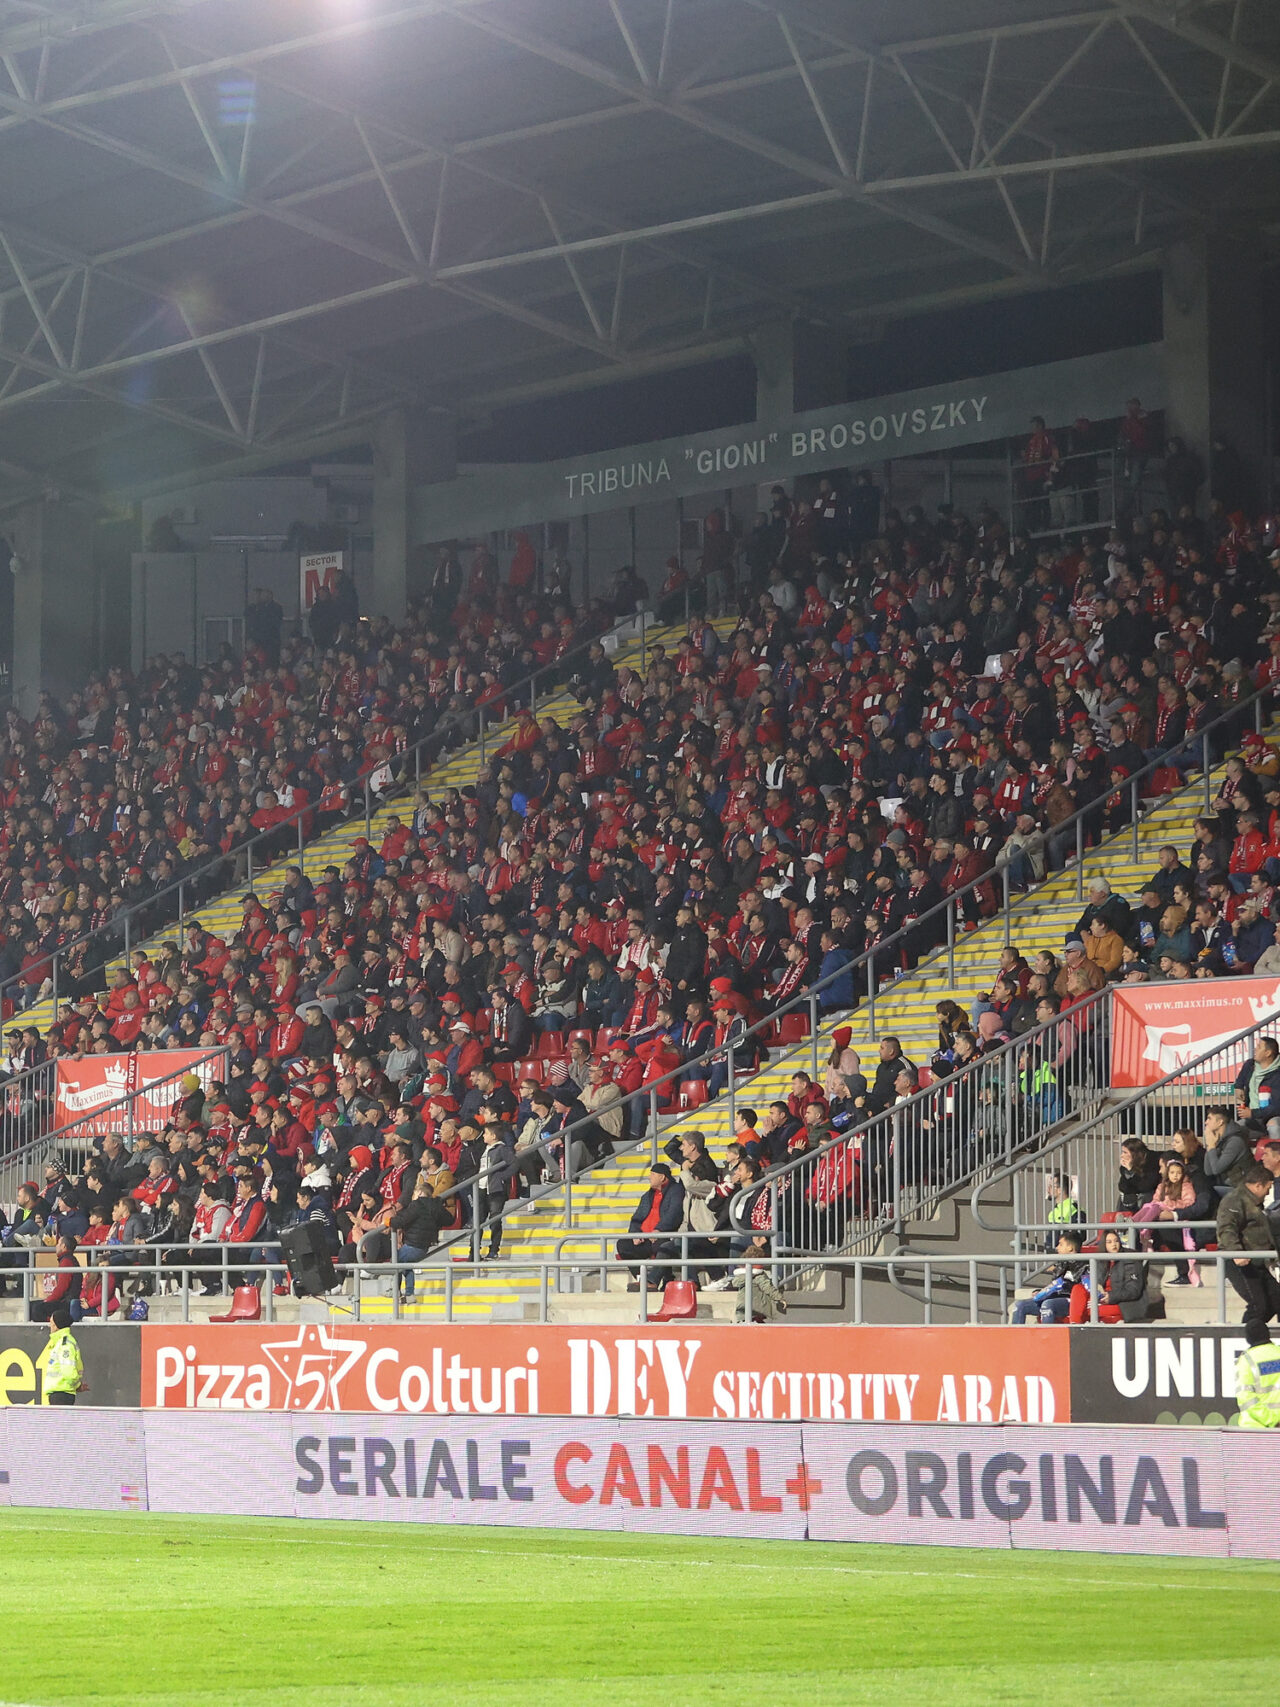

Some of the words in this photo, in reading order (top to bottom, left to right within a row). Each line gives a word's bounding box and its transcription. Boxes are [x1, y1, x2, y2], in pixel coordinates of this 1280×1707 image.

[564, 458, 671, 499] TRIBUNA
[792, 396, 988, 457] BROSOVSZKY
[305, 556, 337, 567] SECTOR
[305, 566, 337, 609] M
[1144, 996, 1244, 1011] www.maxximus.ro
[71, 1088, 114, 1108] Maxximus
[155, 1345, 271, 1409] Pizza
[365, 1346, 540, 1415] Colturi
[567, 1338, 702, 1418] DEY
[712, 1370, 920, 1421] SECURITY
[936, 1374, 1057, 1424] ARAD
[294, 1435, 534, 1502] SERIALE
[553, 1440, 823, 1513] CANAL+
[845, 1448, 1227, 1530] ORIGINAL
